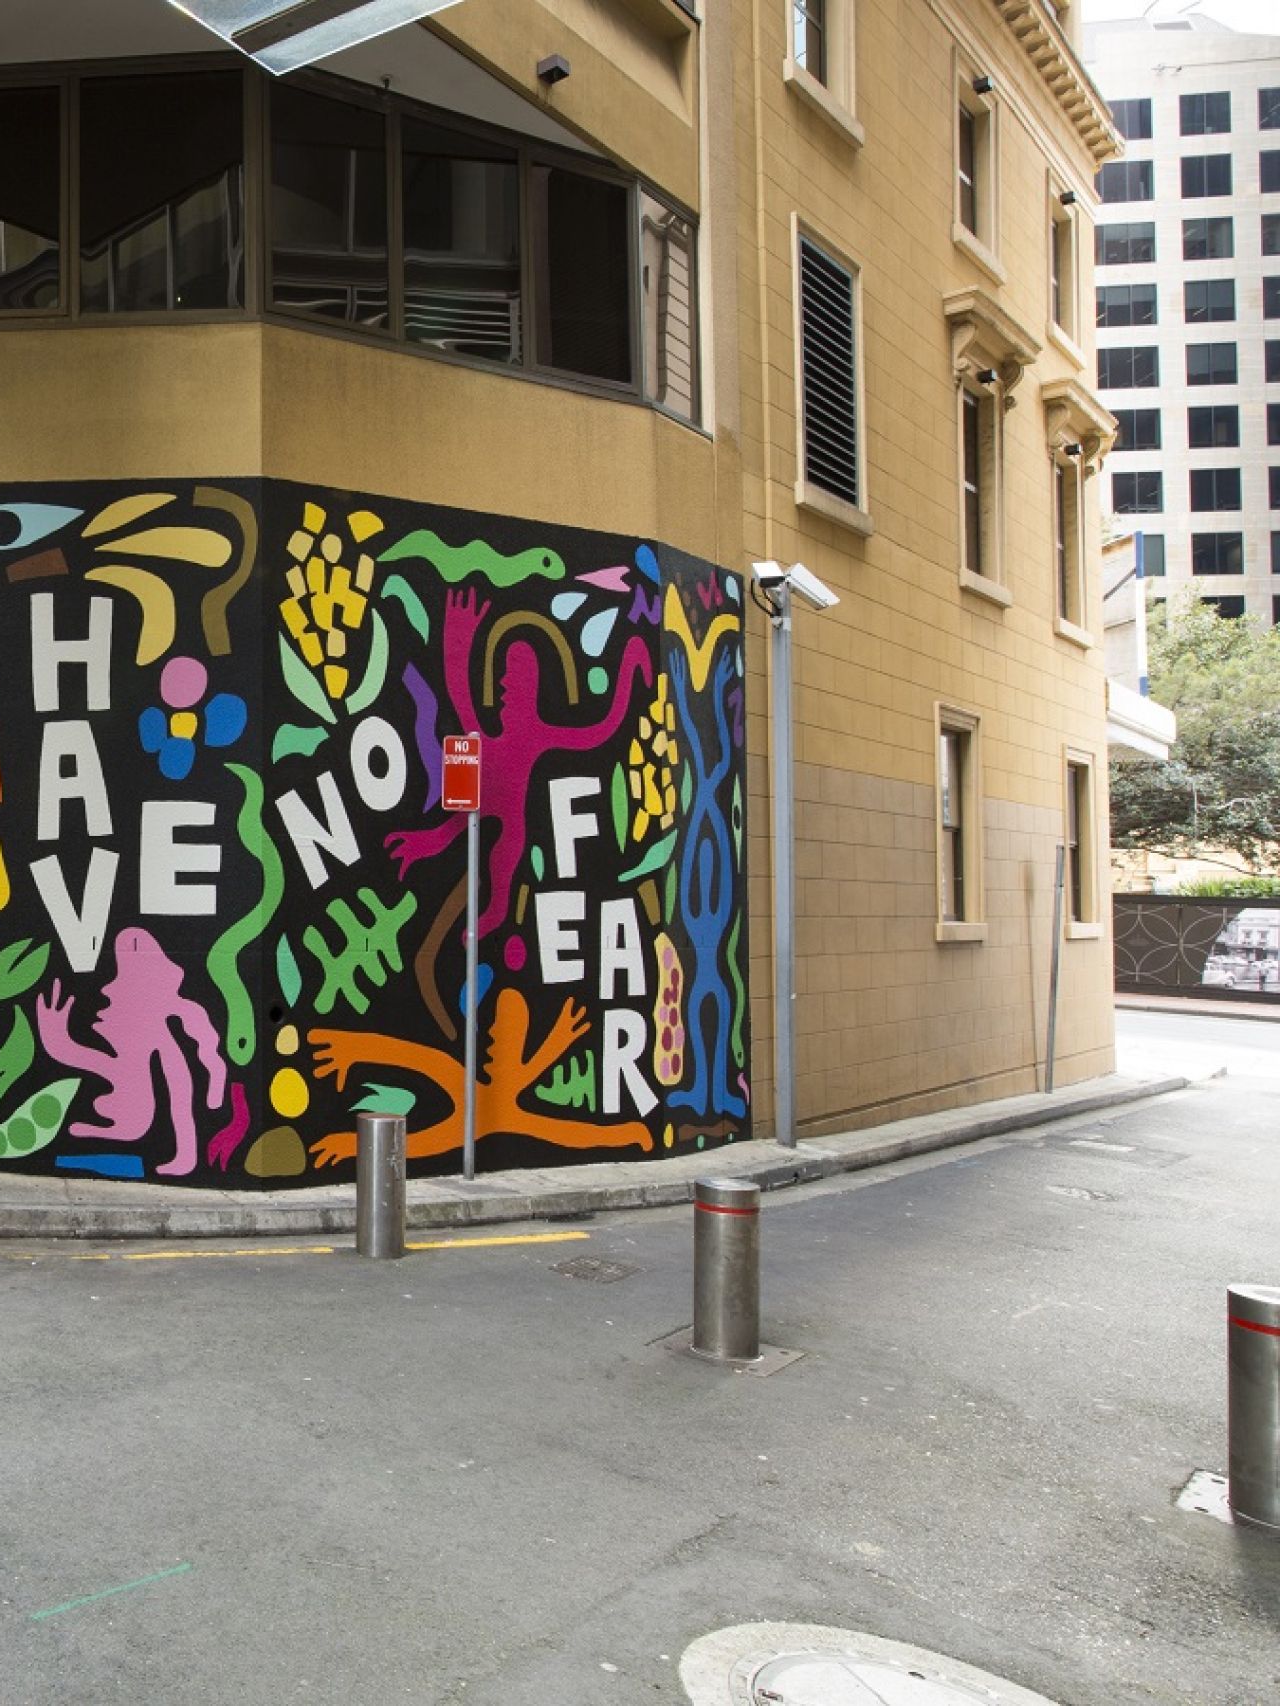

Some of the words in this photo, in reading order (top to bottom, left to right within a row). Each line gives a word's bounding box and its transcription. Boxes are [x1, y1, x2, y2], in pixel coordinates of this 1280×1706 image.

[30, 592, 222, 973] HAVE
[275, 716, 407, 890] NO
[445, 755, 479, 765] STOPPING
[454, 740, 469, 753] NO
[535, 776, 659, 1117] FEAR
